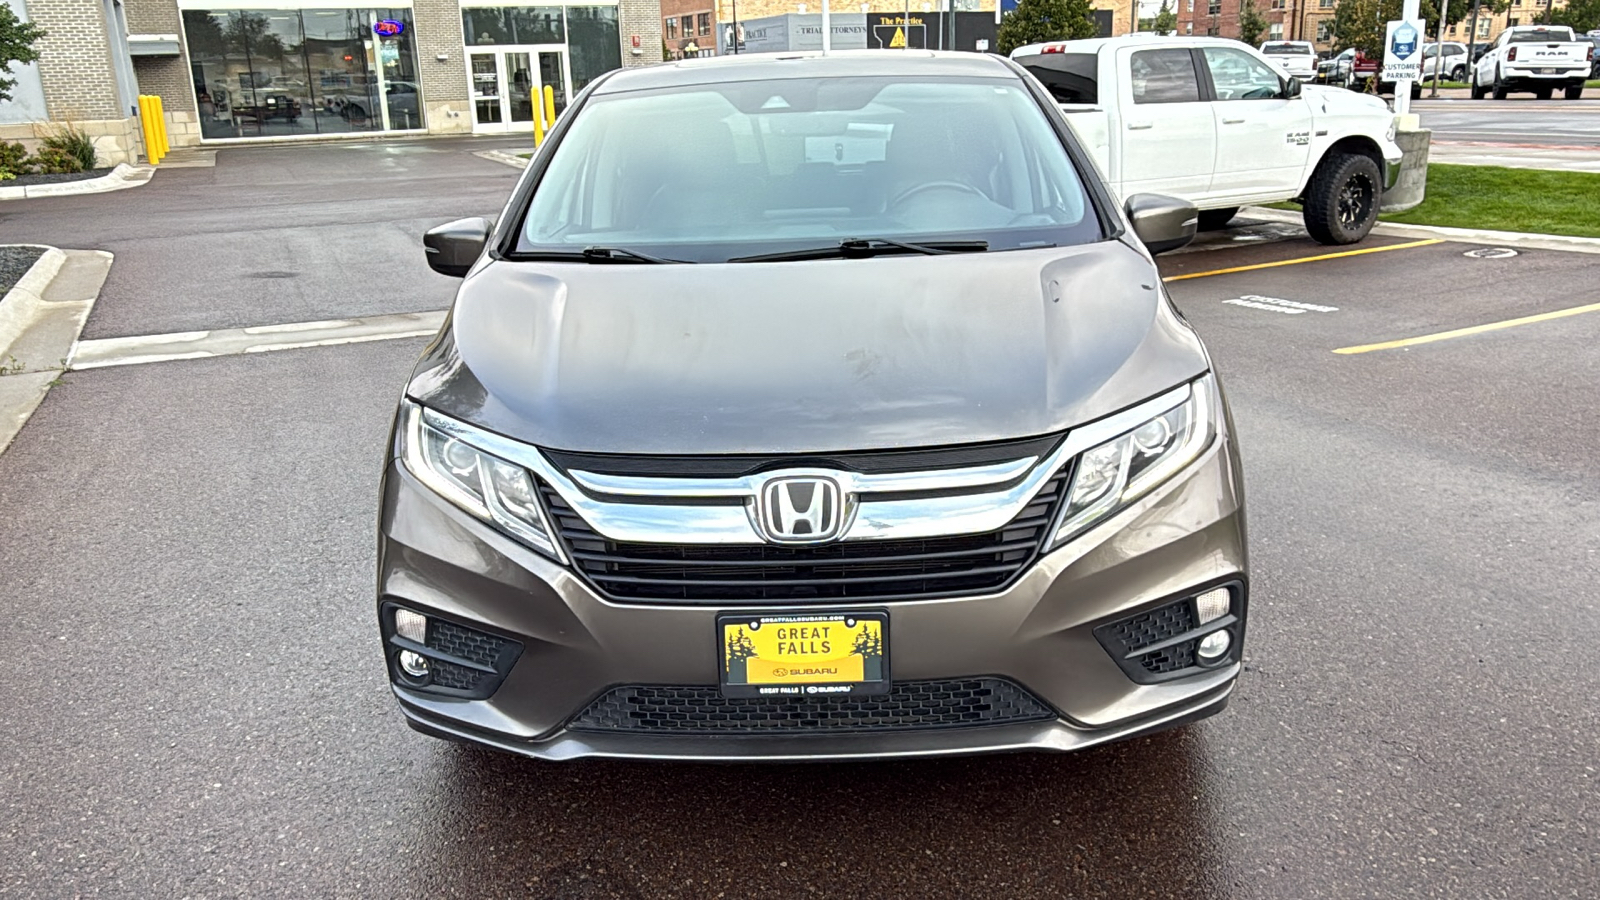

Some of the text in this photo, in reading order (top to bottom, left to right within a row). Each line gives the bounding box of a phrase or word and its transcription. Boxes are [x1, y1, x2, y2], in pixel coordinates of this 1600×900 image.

[880, 16, 894, 25] The
[830, 26, 867, 34] TTORNEYS
[1384, 63, 1420, 71] CUSTOMER
[777, 627, 830, 639] GREAT
[777, 641, 831, 655] FALLS
[818, 685, 851, 693] SUBARU
